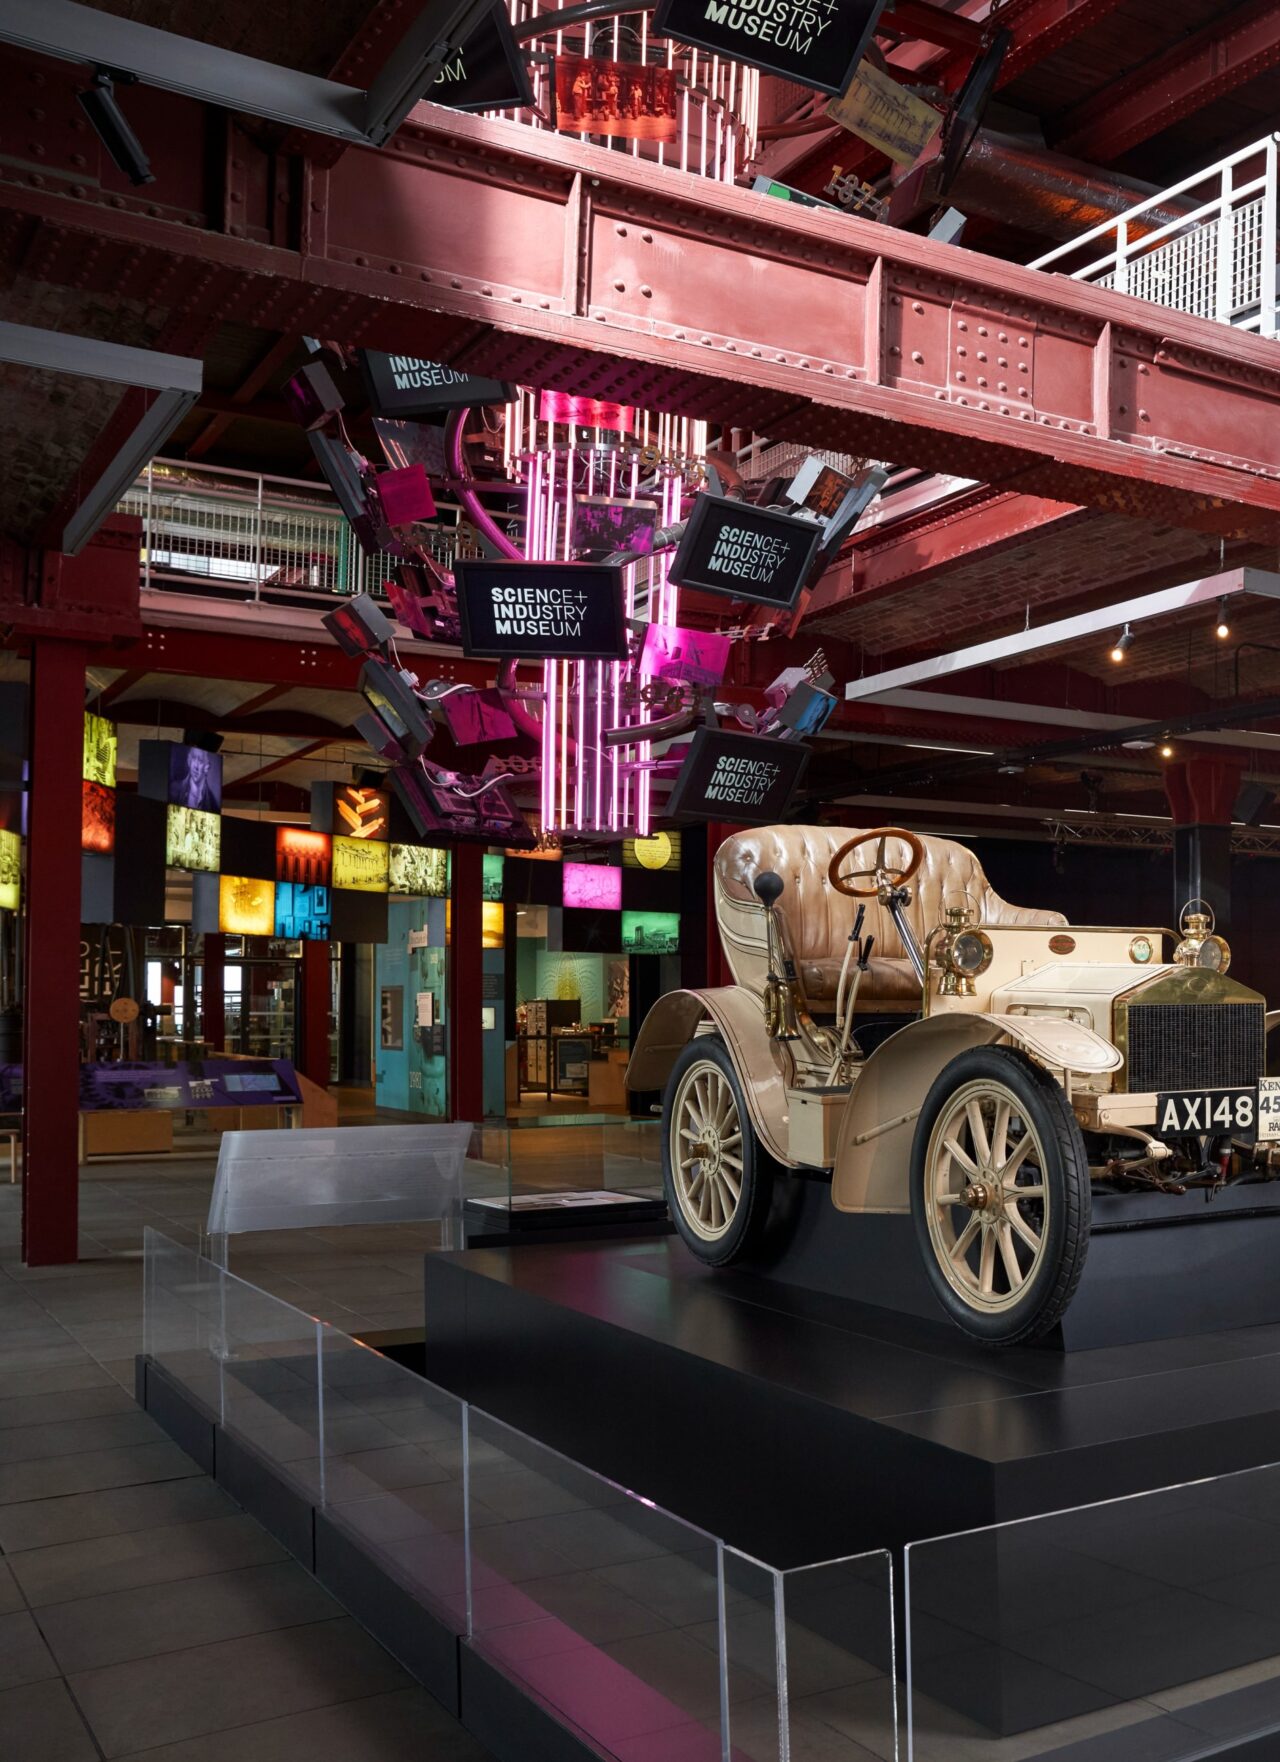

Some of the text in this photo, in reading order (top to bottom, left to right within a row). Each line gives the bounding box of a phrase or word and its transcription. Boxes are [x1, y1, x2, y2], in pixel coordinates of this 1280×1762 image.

[704, 0, 813, 55] MUSEUM
[715, 0, 832, 37] DUSTRY
[394, 369, 469, 390] MUSEUM
[719, 525, 791, 554] SCIENCE+
[713, 540, 786, 569] INDUSTRY
[707, 555, 774, 584] MUSEUM
[490, 587, 588, 606] SCIENCE+
[493, 603, 588, 622] INDUSTRY
[494, 619, 582, 637] MUSEUM
[716, 755, 781, 776] SCIENCE+
[710, 770, 776, 791] INDUSTRY
[704, 785, 764, 806] MUSEUM
[1161, 1095, 1254, 1132] AX148
